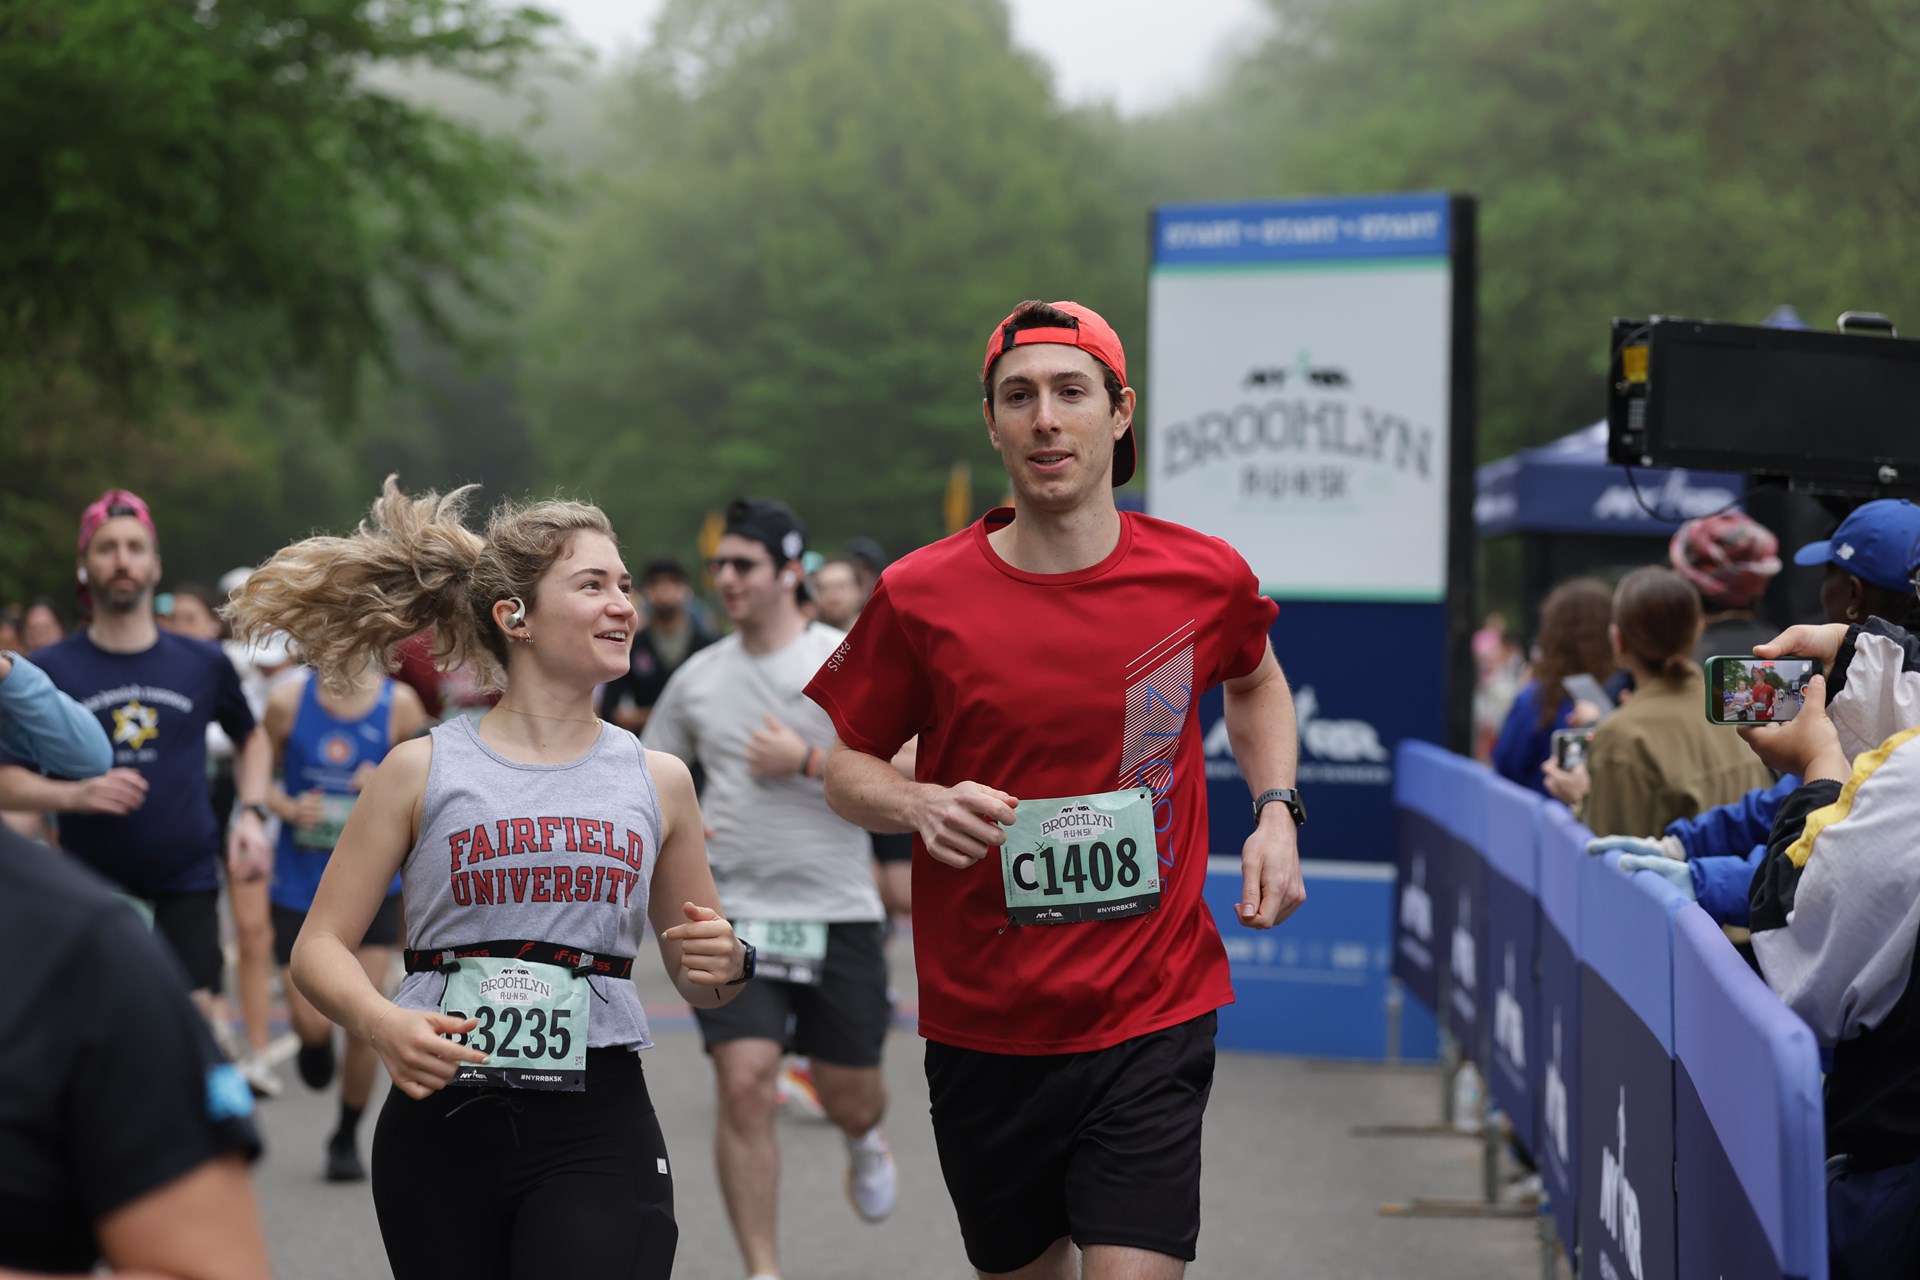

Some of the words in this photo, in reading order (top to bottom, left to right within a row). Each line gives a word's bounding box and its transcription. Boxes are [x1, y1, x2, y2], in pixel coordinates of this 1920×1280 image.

[828, 641, 851, 672] PARIS
[1041, 814, 1114, 835] BROOKLYN
[449, 816, 643, 872] FAIRFIELD
[1012, 837, 1141, 896] C1408
[451, 866, 640, 907] UNIVERSITY
[480, 977, 550, 997] BROOKLYN
